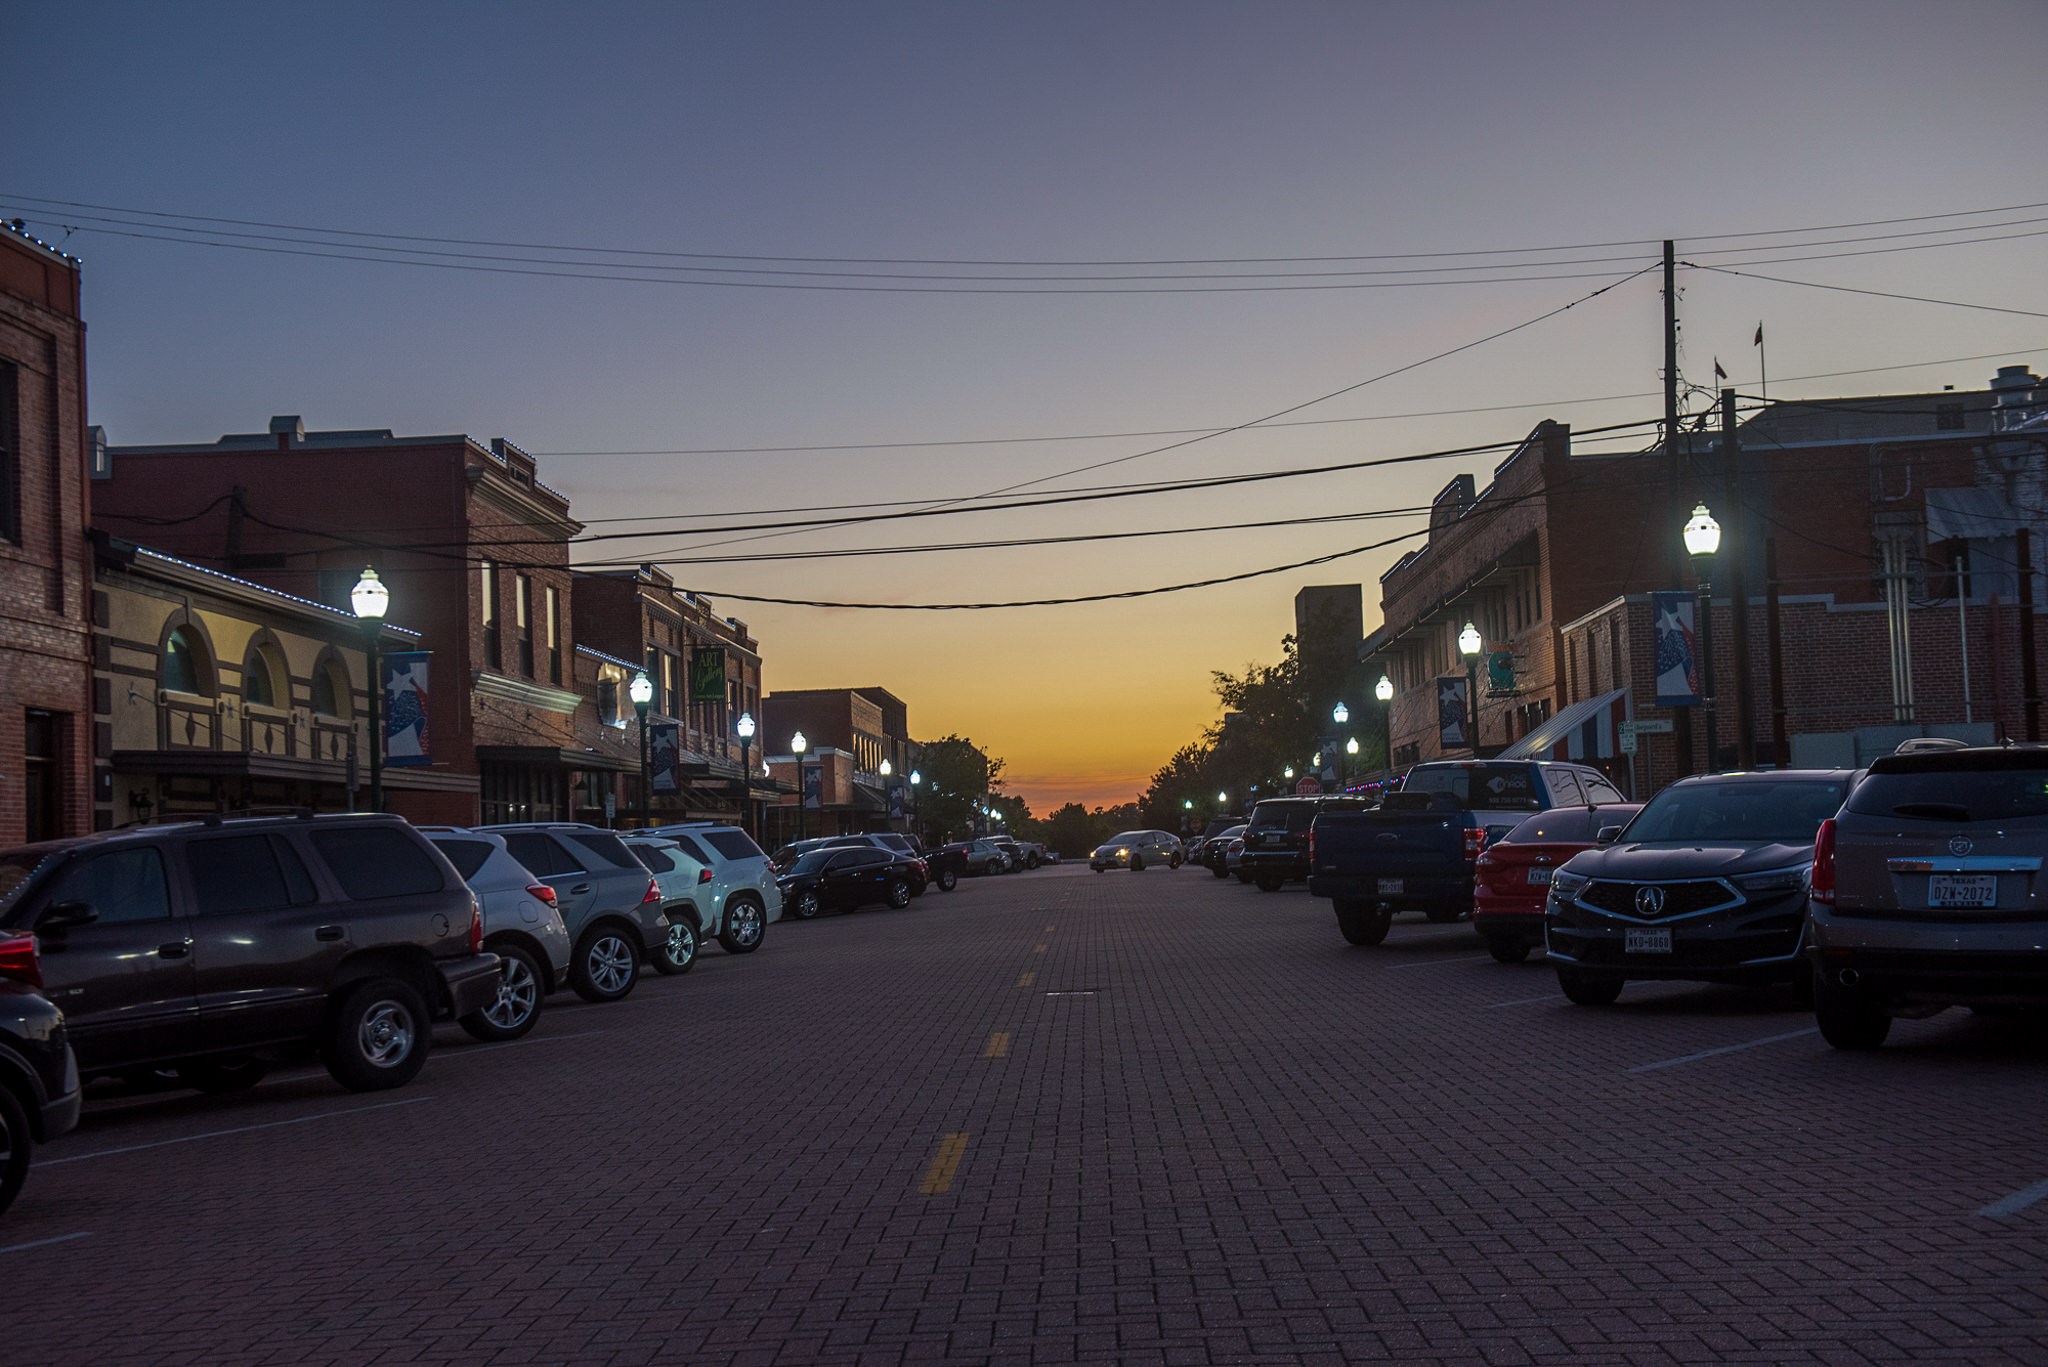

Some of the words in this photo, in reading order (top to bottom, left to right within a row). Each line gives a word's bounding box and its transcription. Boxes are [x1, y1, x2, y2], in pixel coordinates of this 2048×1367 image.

[699, 652, 719, 667] ART
[695, 666, 723, 691] Gallery
[1299, 784, 1318, 794] STOP
